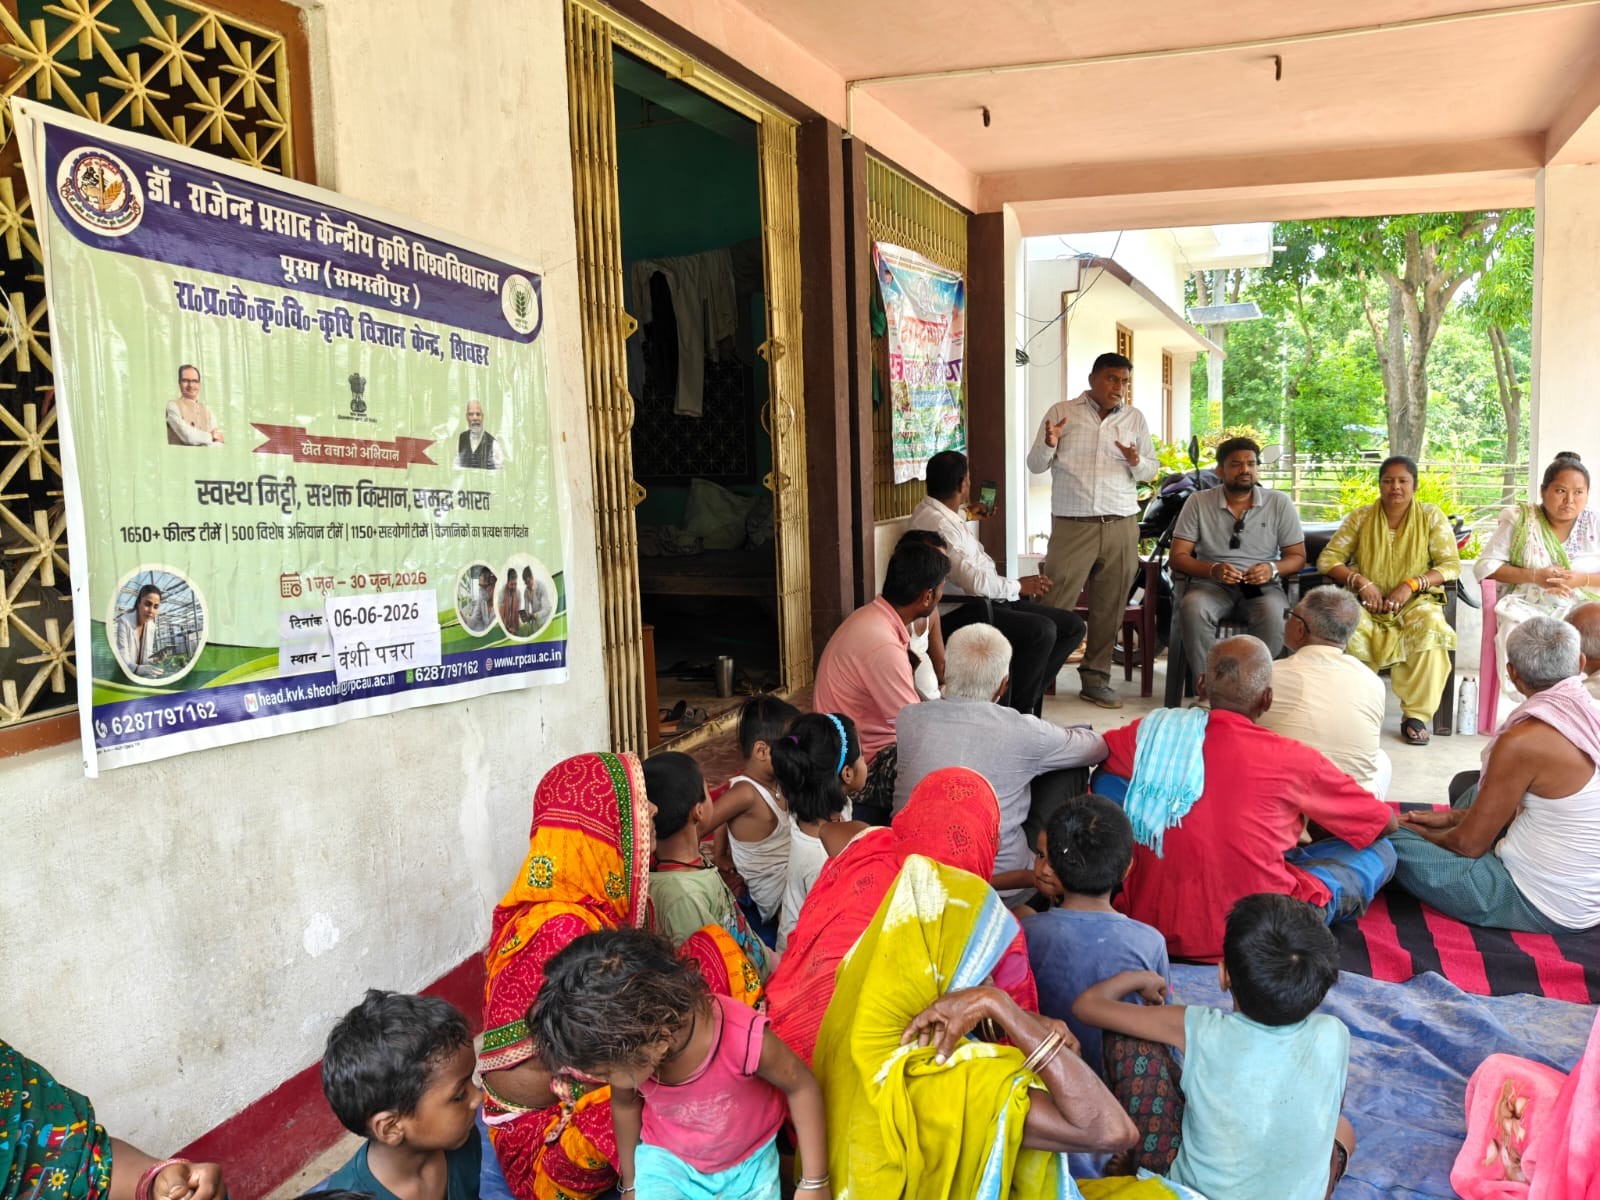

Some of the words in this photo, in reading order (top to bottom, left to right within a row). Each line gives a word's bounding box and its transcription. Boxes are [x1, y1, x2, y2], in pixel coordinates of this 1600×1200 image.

[145, 165, 181, 209] डॉ.
[187, 181, 254, 226] राजेन्द्र
[257, 202, 313, 241] प्रसाद
[315, 212, 374, 258] केन्द्रीय
[377, 235, 410, 271] कृषि
[412, 241, 499, 295] विश्वविद्यालय
[279, 253, 321, 286] पूसा
[358, 311, 406, 350] विज्ञान
[410, 323, 445, 362] केन्द्र,
[449, 332, 489, 366] शिवहर
[300, 440, 322, 457] खेत
[323, 442, 358, 458] बचाओ
[360, 444, 400, 462] अभियान
[194, 479, 253, 506] स्वस्थ
[256, 474, 302, 514] मिट्टी,
[304, 483, 354, 508] सशक्त
[356, 479, 412, 512] किसान,
[412, 488, 454, 518] समृद्ध
[457, 489, 491, 511] भारत
[120, 526, 161, 543] 1650+
[162, 522, 197, 542] फील्ड
[198, 521, 223, 542] टीमें
[231, 525, 255, 541] 500
[256, 521, 285, 541] विशेष
[287, 521, 325, 540] अभियान
[326, 521, 344, 540] टीमें
[351, 525, 377, 539] 1150+
[378, 521, 410, 540] सहयोगी
[411, 522, 430, 540] टीमें
[471, 525, 481, 539] का
[306, 577, 313, 592] 1
[314, 575, 335, 596] जून
[351, 575, 367, 590] 30
[289, 614, 323, 630] दिनांक
[333, 602, 419, 628] 06-06-2026
[290, 651, 317, 666] स्थान
[494, 649, 563, 669] www.rpcau.ac.in
[415, 660, 479, 683] 6287797162
[110, 701, 218, 736] 6287797162
